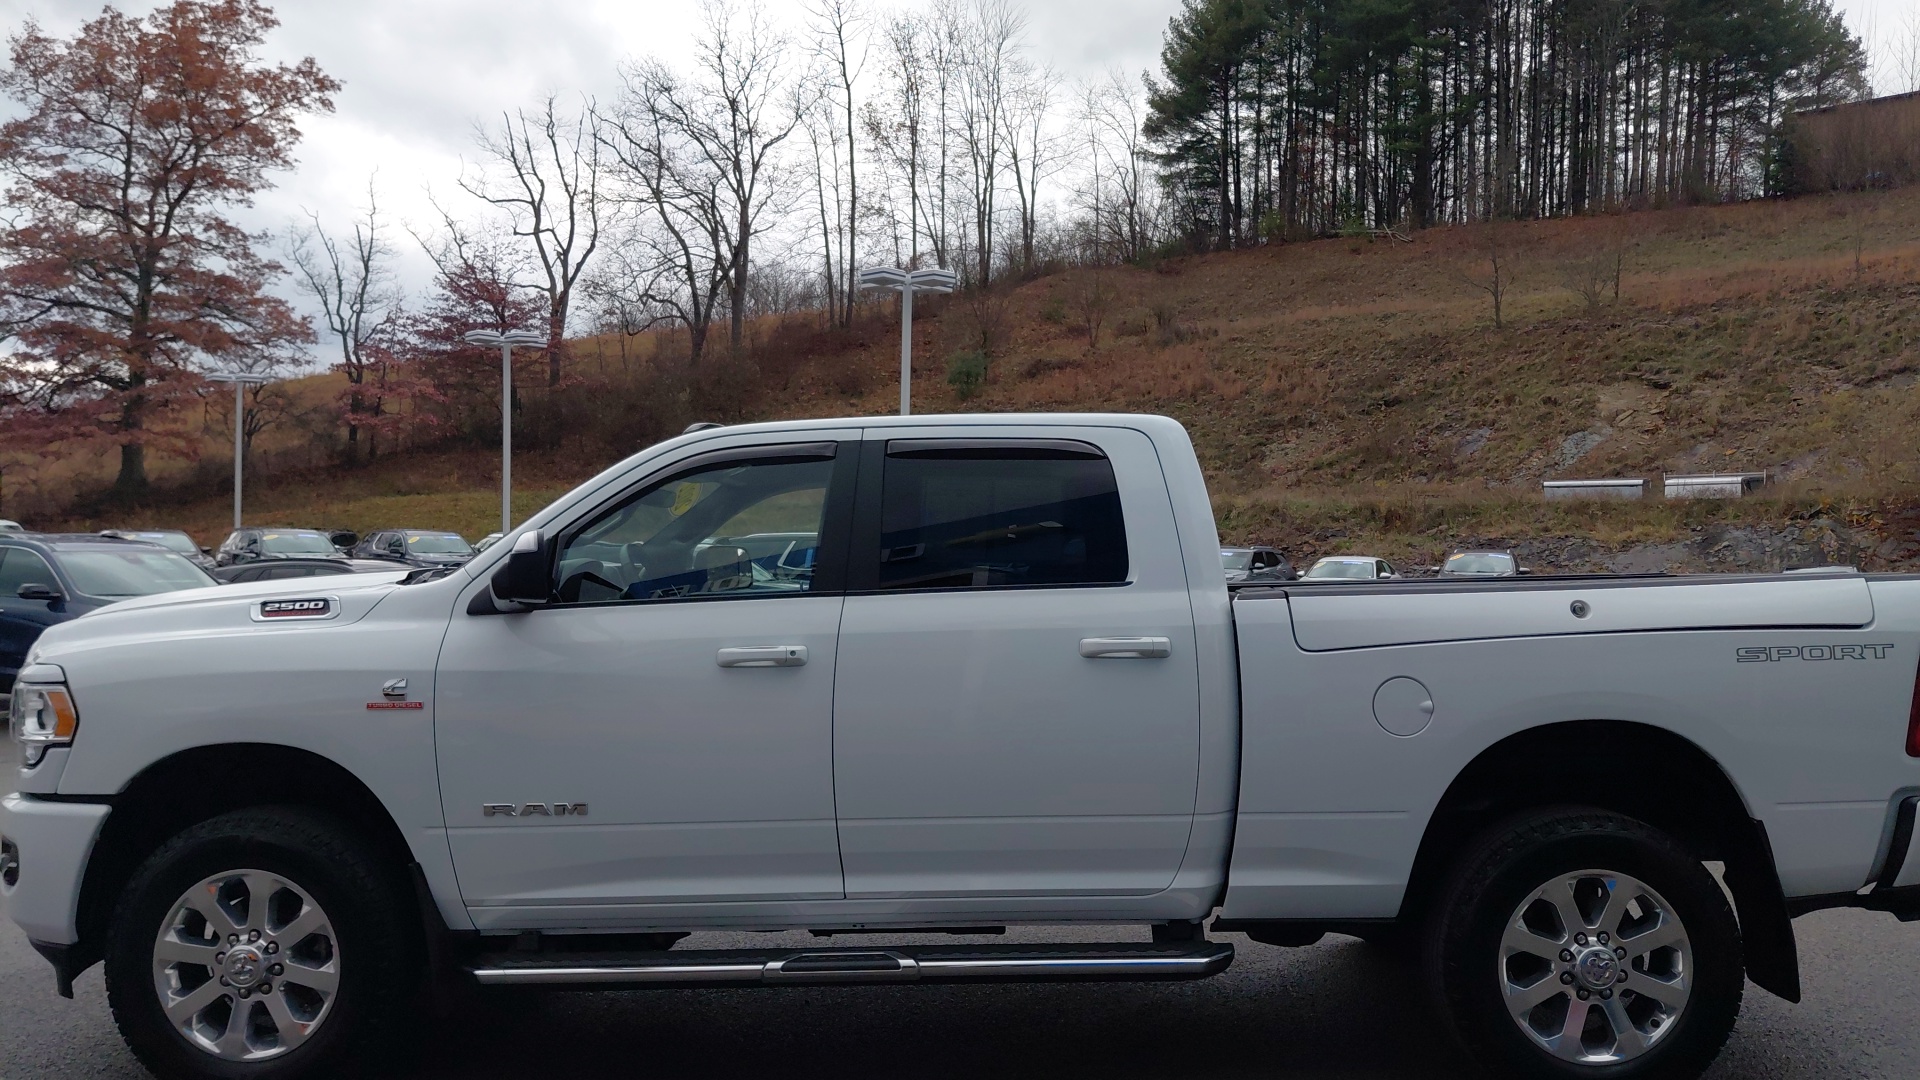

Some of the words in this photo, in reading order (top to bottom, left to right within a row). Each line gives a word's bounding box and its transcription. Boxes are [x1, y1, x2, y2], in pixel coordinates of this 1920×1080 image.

[264, 601, 325, 611] 2500
[1736, 643, 1895, 663] SPORT
[483, 803, 588, 816] RAM
